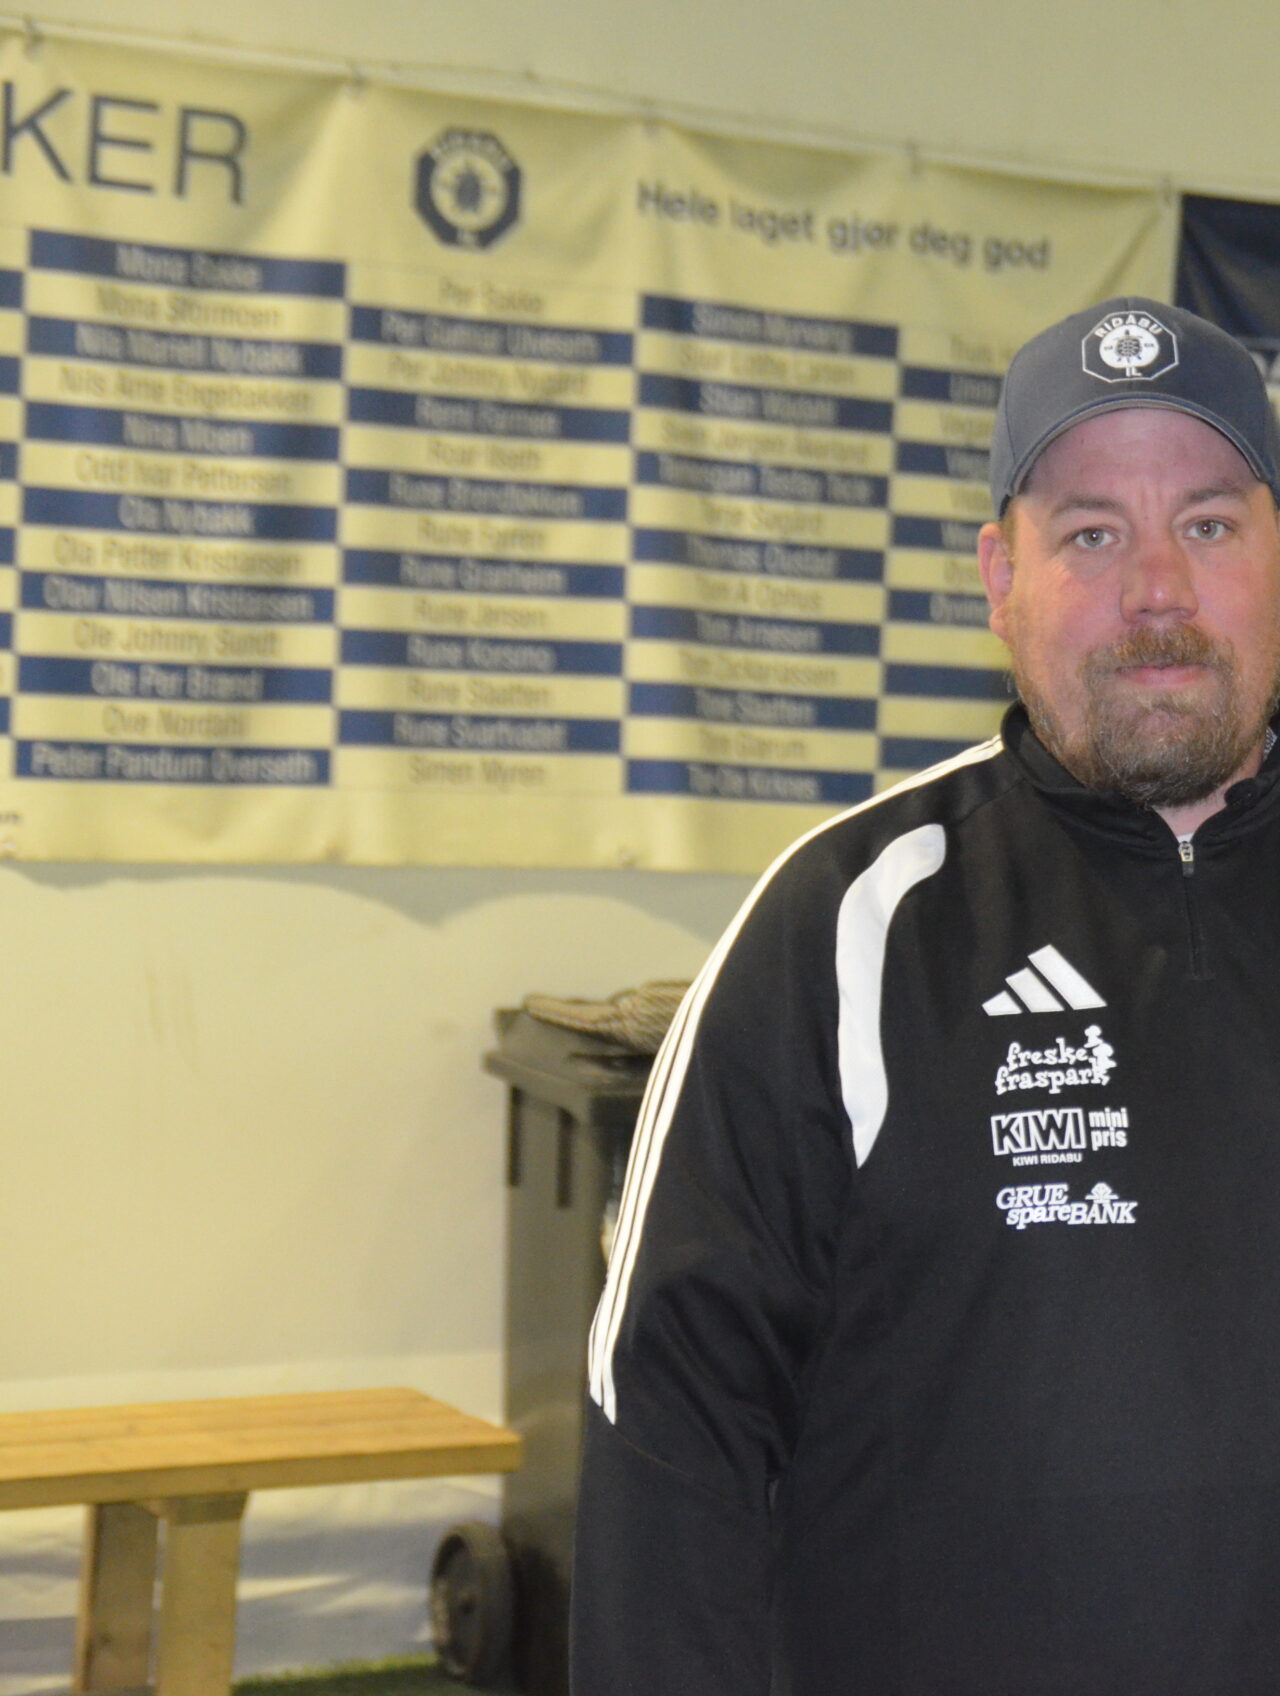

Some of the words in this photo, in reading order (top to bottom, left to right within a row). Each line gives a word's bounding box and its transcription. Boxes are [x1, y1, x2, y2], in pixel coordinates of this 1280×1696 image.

[638, 181, 719, 227] Hele
[729, 194, 814, 246] laget
[826, 215, 899, 254] gjør
[909, 218, 972, 265] deg
[983, 233, 1050, 271] god
[1094, 314, 1162, 338] RIDABU
[1126, 367, 1142, 378] IL
[1006, 1037, 1089, 1072] freske
[995, 1056, 1110, 1096] fraspark
[991, 1107, 1087, 1156] KIWI
[1088, 1106, 1129, 1128] mini
[1090, 1127, 1128, 1151] pris
[1012, 1155, 1039, 1167] KIWI
[1040, 1152, 1083, 1164] RIDABU
[996, 1182, 1069, 1210] GRUE
[1006, 1201, 1138, 1229] spareBANK
